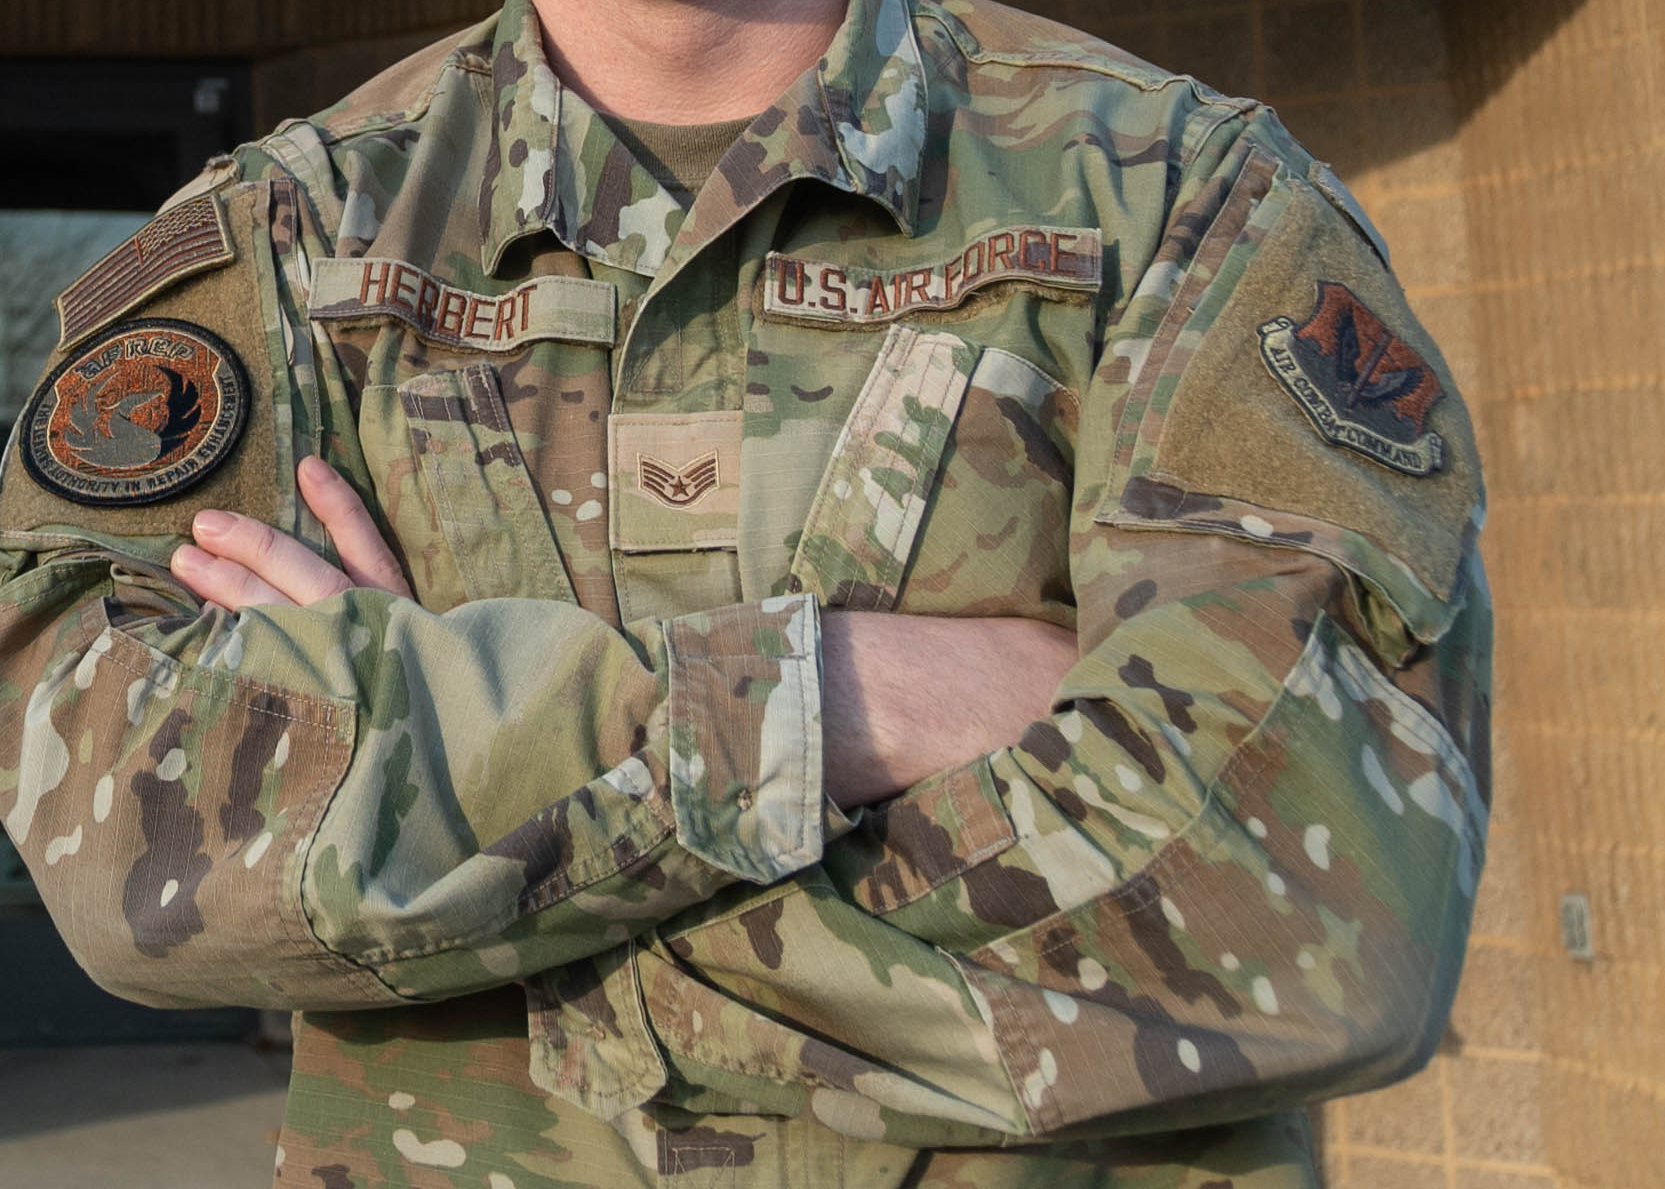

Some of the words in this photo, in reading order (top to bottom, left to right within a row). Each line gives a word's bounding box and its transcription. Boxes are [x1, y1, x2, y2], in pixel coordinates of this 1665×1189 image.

[359, 261, 539, 341] HERBERT
[777, 260, 858, 314] U.S.
[864, 268, 934, 315] AIR
[944, 229, 1079, 301] FORCE
[1269, 346, 1297, 374] AIR
[1293, 377, 1346, 439] COMBAT
[1347, 425, 1422, 469] COMMAND
[47, 464, 121, 492] AUTHORITY
[124, 479, 141, 492] IN
[146, 458, 199, 490] REPAIR
